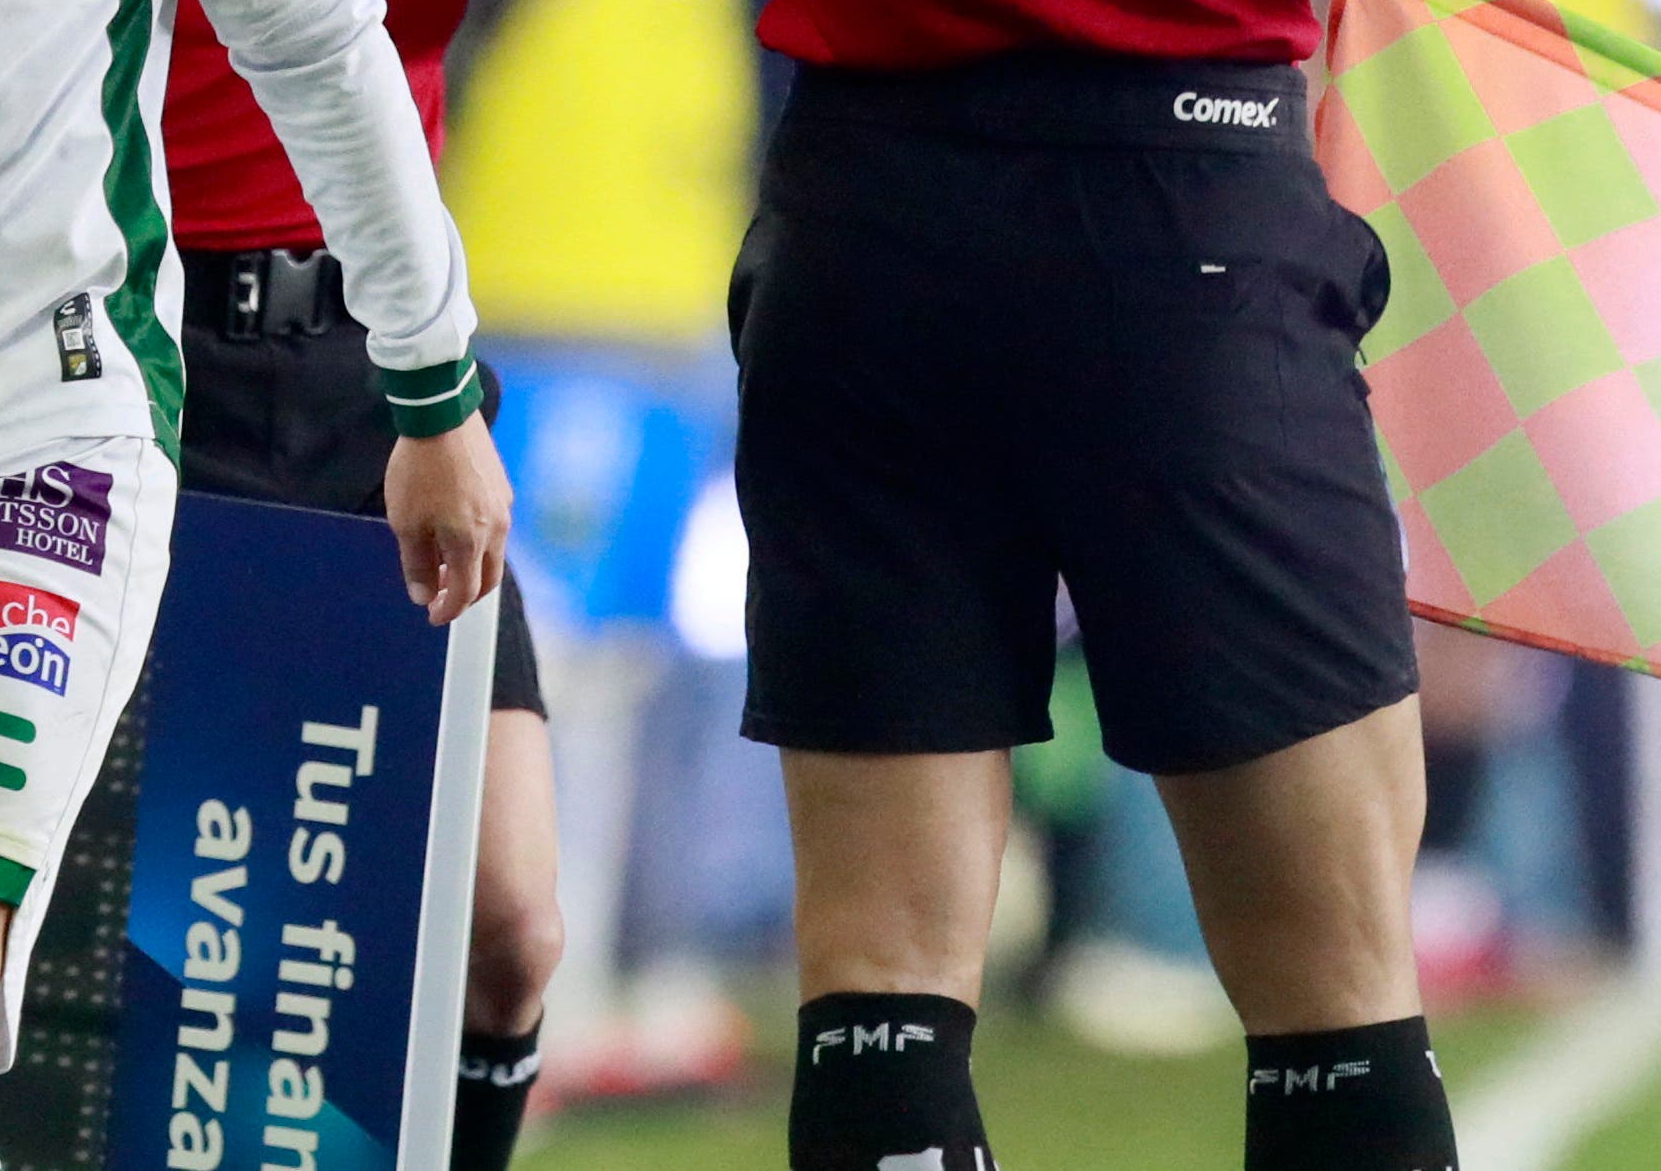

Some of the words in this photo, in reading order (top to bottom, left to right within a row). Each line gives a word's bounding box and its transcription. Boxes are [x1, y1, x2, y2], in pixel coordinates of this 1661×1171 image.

[1172, 90, 1280, 129] Comex
[14, 527, 94, 566] HOTEL
[288, 704, 380, 886] Tus
[166, 797, 256, 1171] avanza
[811, 1021, 937, 1067] FMF
[1248, 1059, 1372, 1096] FMF
